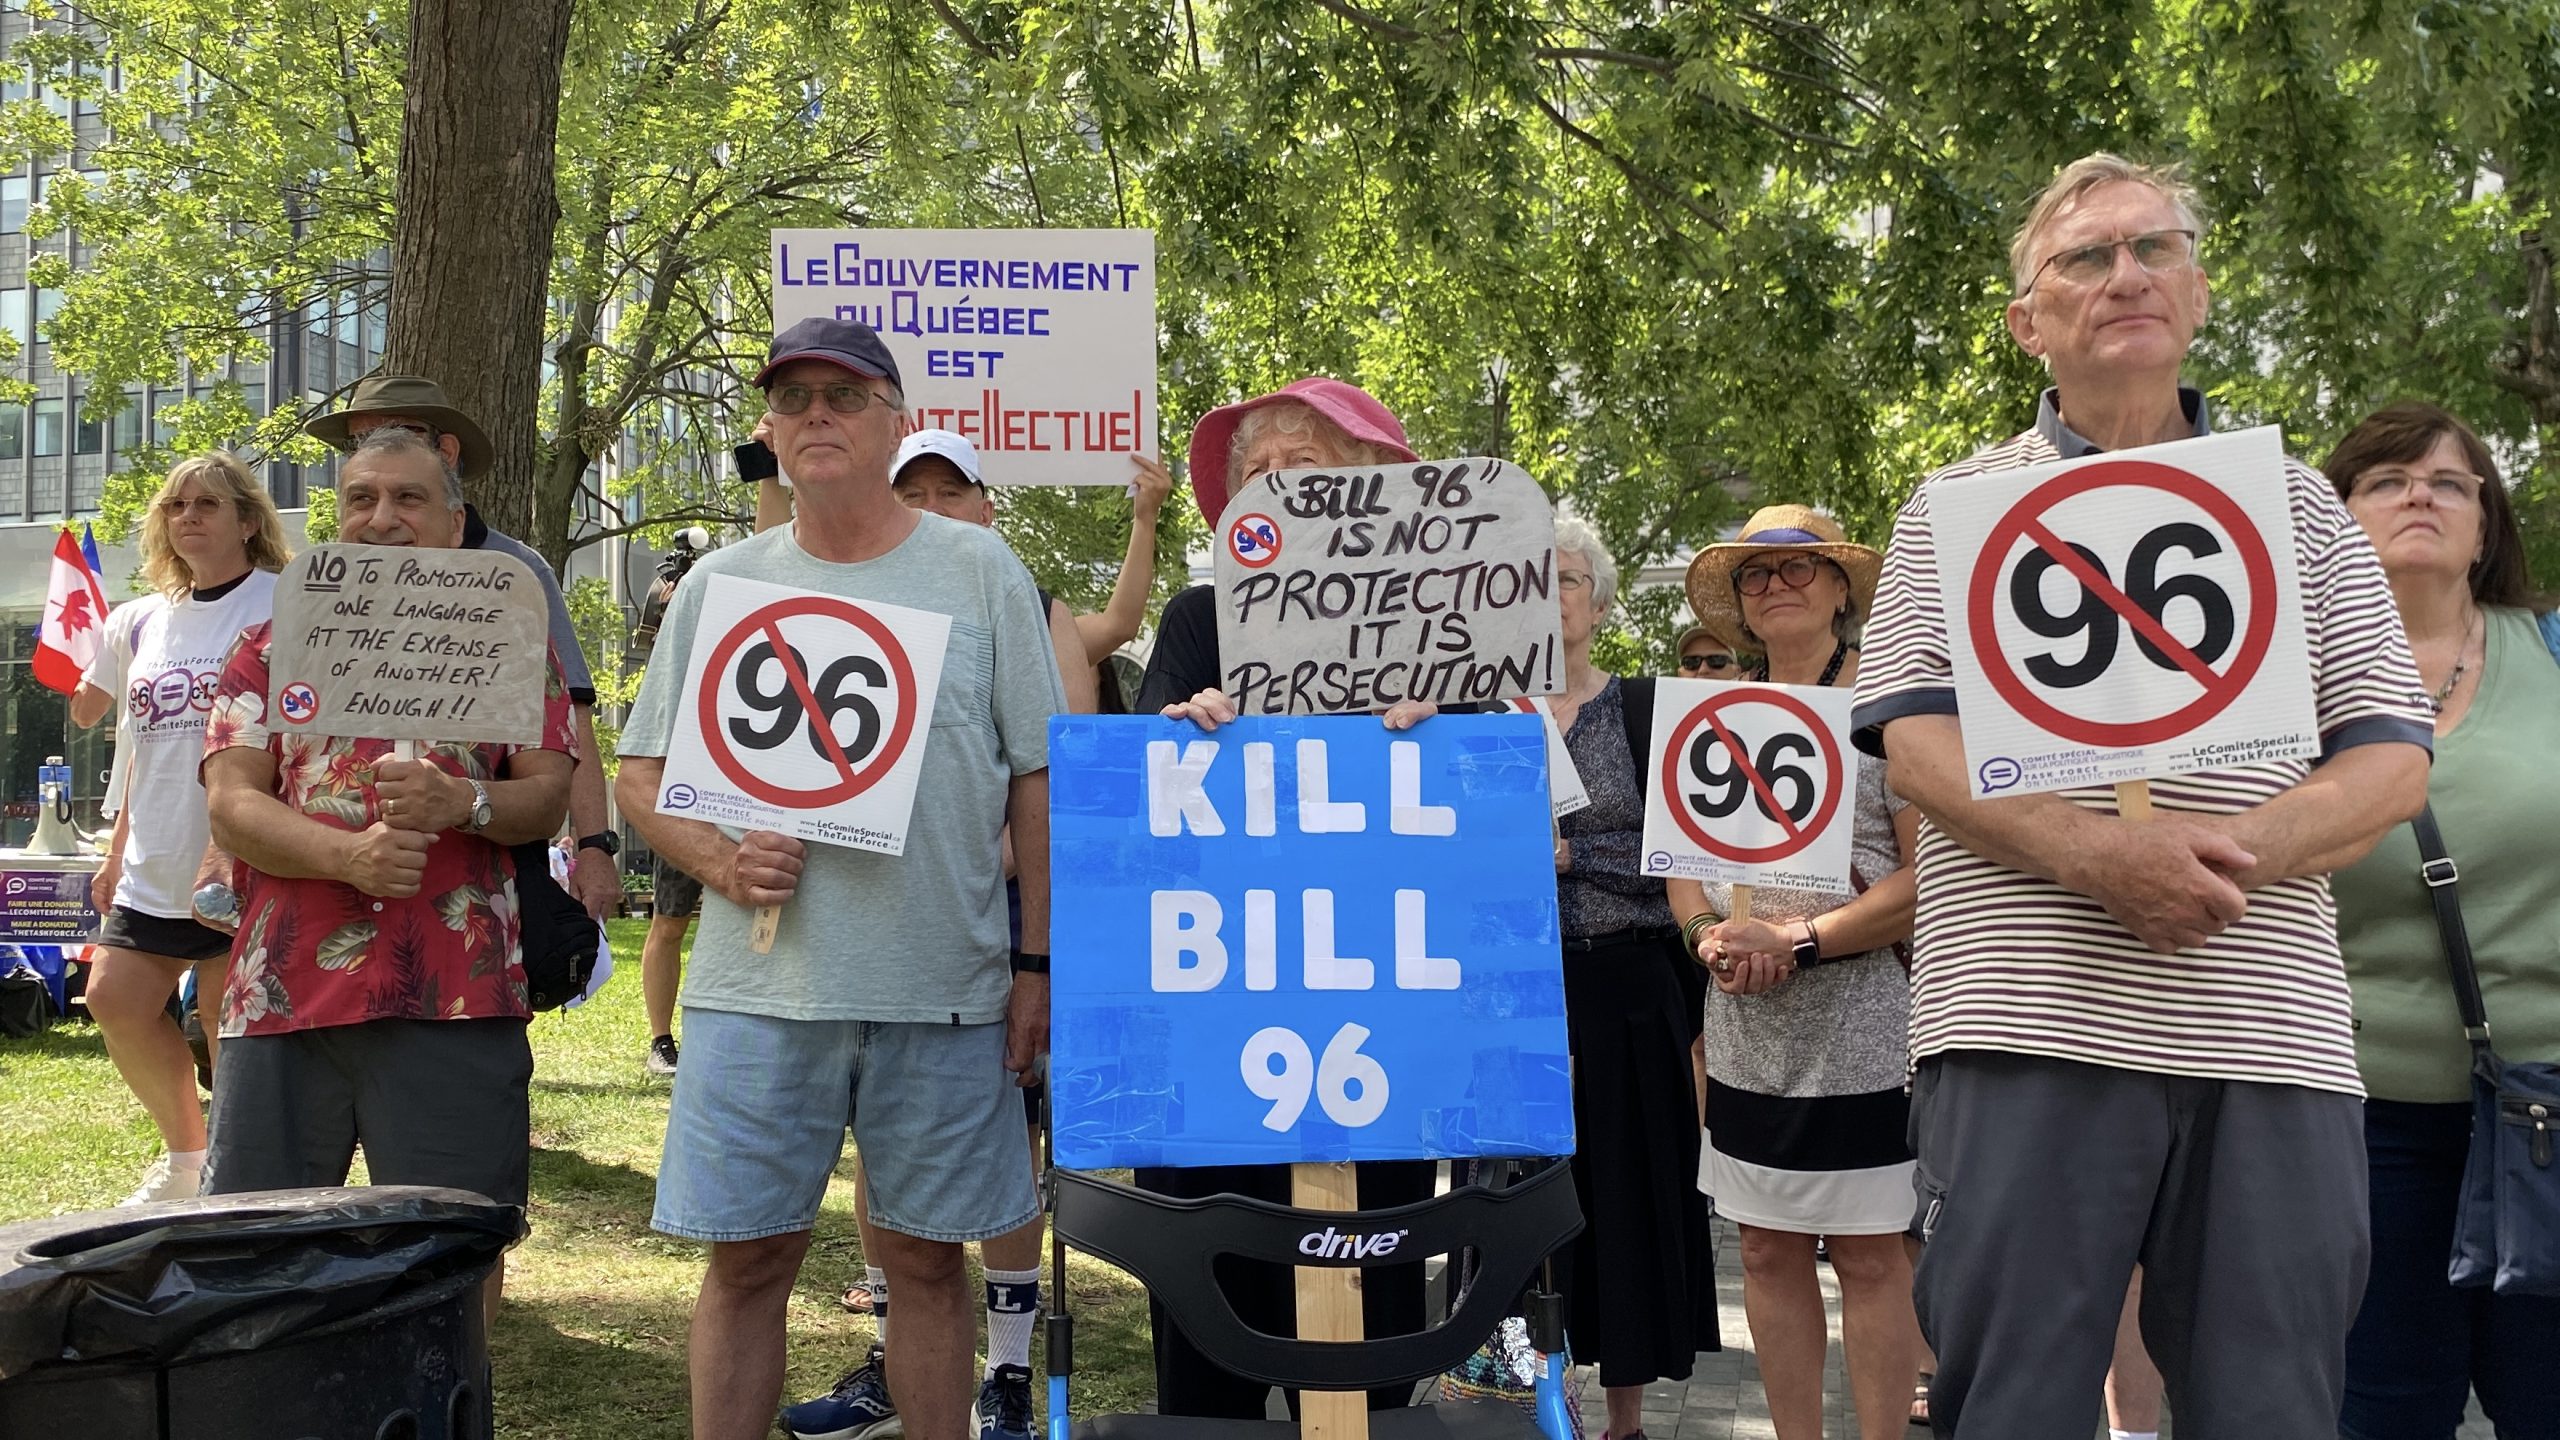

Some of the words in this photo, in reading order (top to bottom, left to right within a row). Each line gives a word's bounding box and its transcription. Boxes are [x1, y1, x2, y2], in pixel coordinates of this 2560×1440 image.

[834, 243, 1140, 292] GOUVERNEMENT
[892, 291, 1050, 337] QUÉBEC
[927, 350, 1004, 378] EST
[1327, 522, 1376, 558] IS
[1382, 511, 1500, 557] NOT
[306, 550, 347, 583] NO
[1232, 548, 1552, 624] PROTECTION
[333, 594, 374, 617] ONE
[393, 596, 504, 624] LANGUAGE
[2011, 523, 2235, 689] 96
[305, 626, 339, 649] AT
[346, 627, 395, 651] THE
[401, 631, 509, 659] EXPENSE
[1349, 620, 1401, 659] IT
[1417, 612, 1472, 655] IS
[330, 658, 359, 677] OF
[373, 661, 500, 687] ANOTHER!
[1227, 633, 1554, 715] PERSECUTION!
[728, 642, 888, 764] 96
[1688, 729, 1815, 823] 96
[2021, 753, 2056, 764] COMITÉ
[2060, 749, 2097, 760] SPÉCIAL
[2024, 771, 2053, 780] TASK
[2060, 765, 2099, 776] FORCE
[2108, 766, 2147, 777] POLICY
[1147, 739, 1457, 837] KILL
[1152, 889, 1461, 993] BILL
[1240, 1023, 1389, 1132] 96
